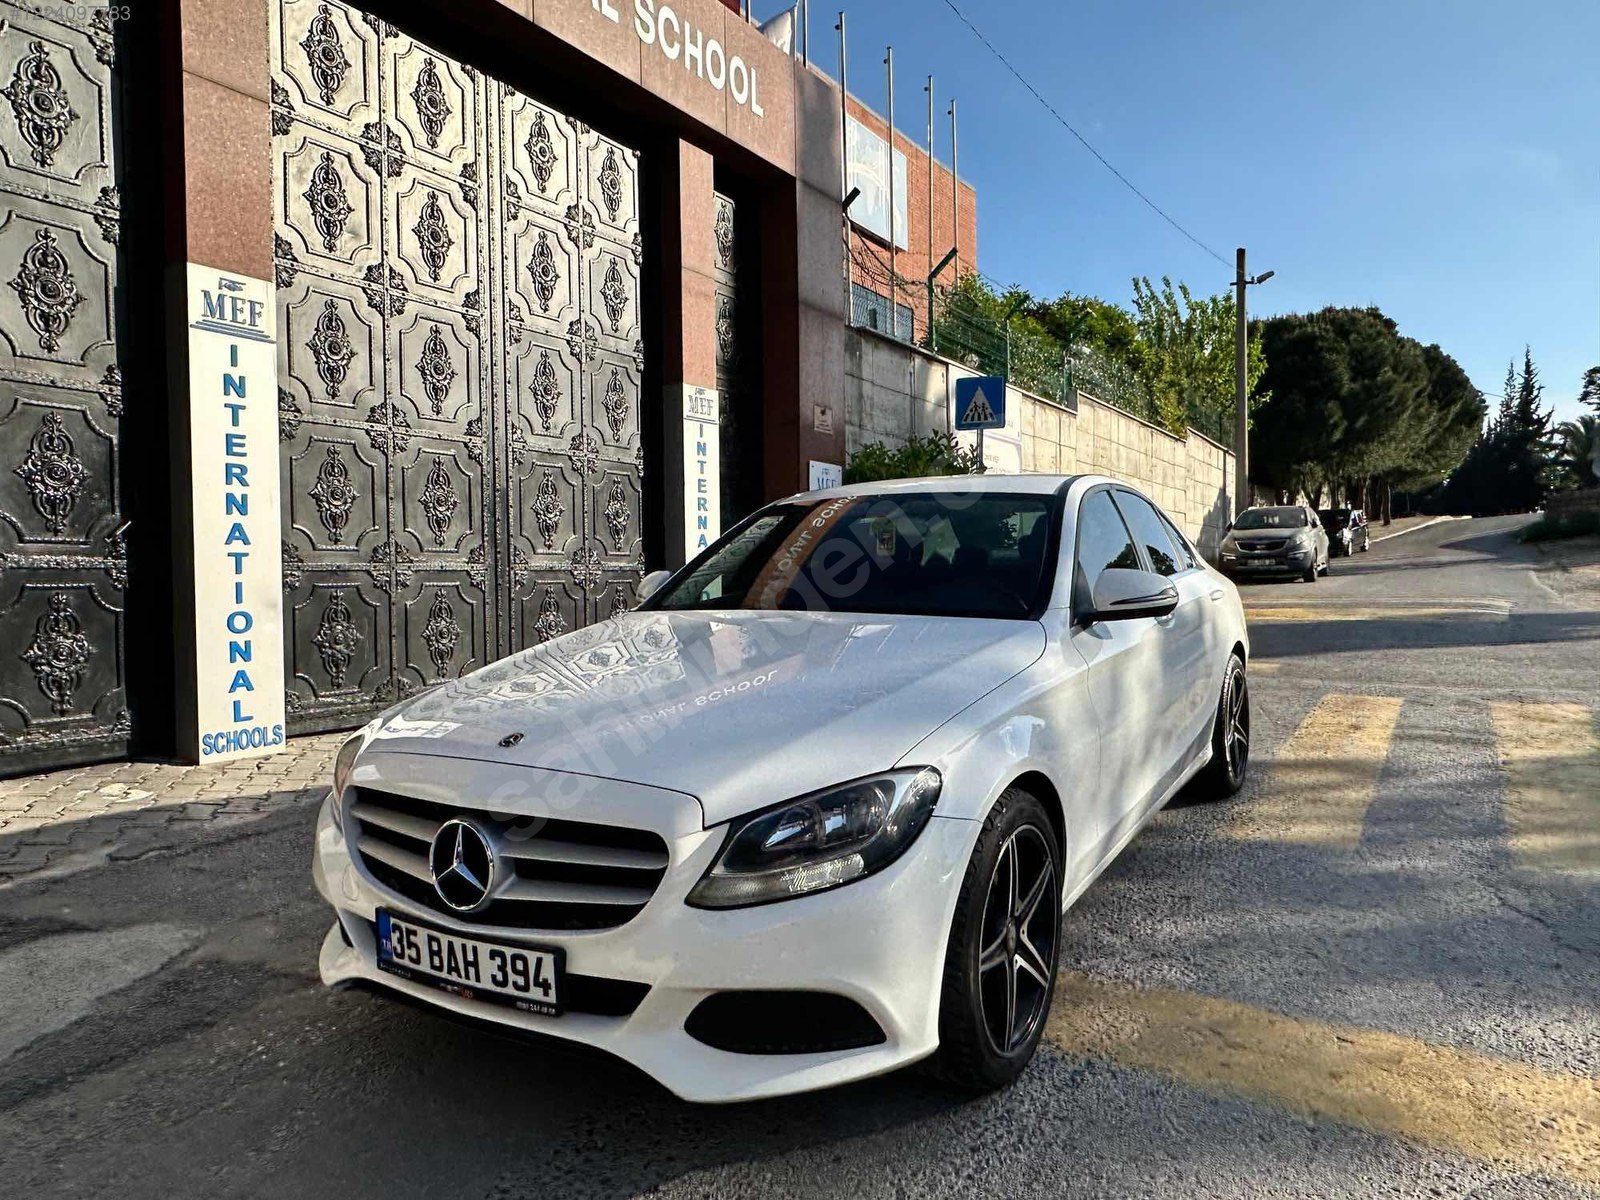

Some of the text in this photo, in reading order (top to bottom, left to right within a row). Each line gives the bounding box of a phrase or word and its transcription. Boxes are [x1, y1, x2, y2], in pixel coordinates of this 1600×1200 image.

[634, 0, 764, 118] SCHOOL
[201, 289, 265, 327] MEF
[688, 394, 715, 416] MEF
[223, 344, 255, 722] INTERNATIONAL
[202, 724, 283, 756] SCHOOLS
[392, 923, 552, 998] 35 BAH 394
